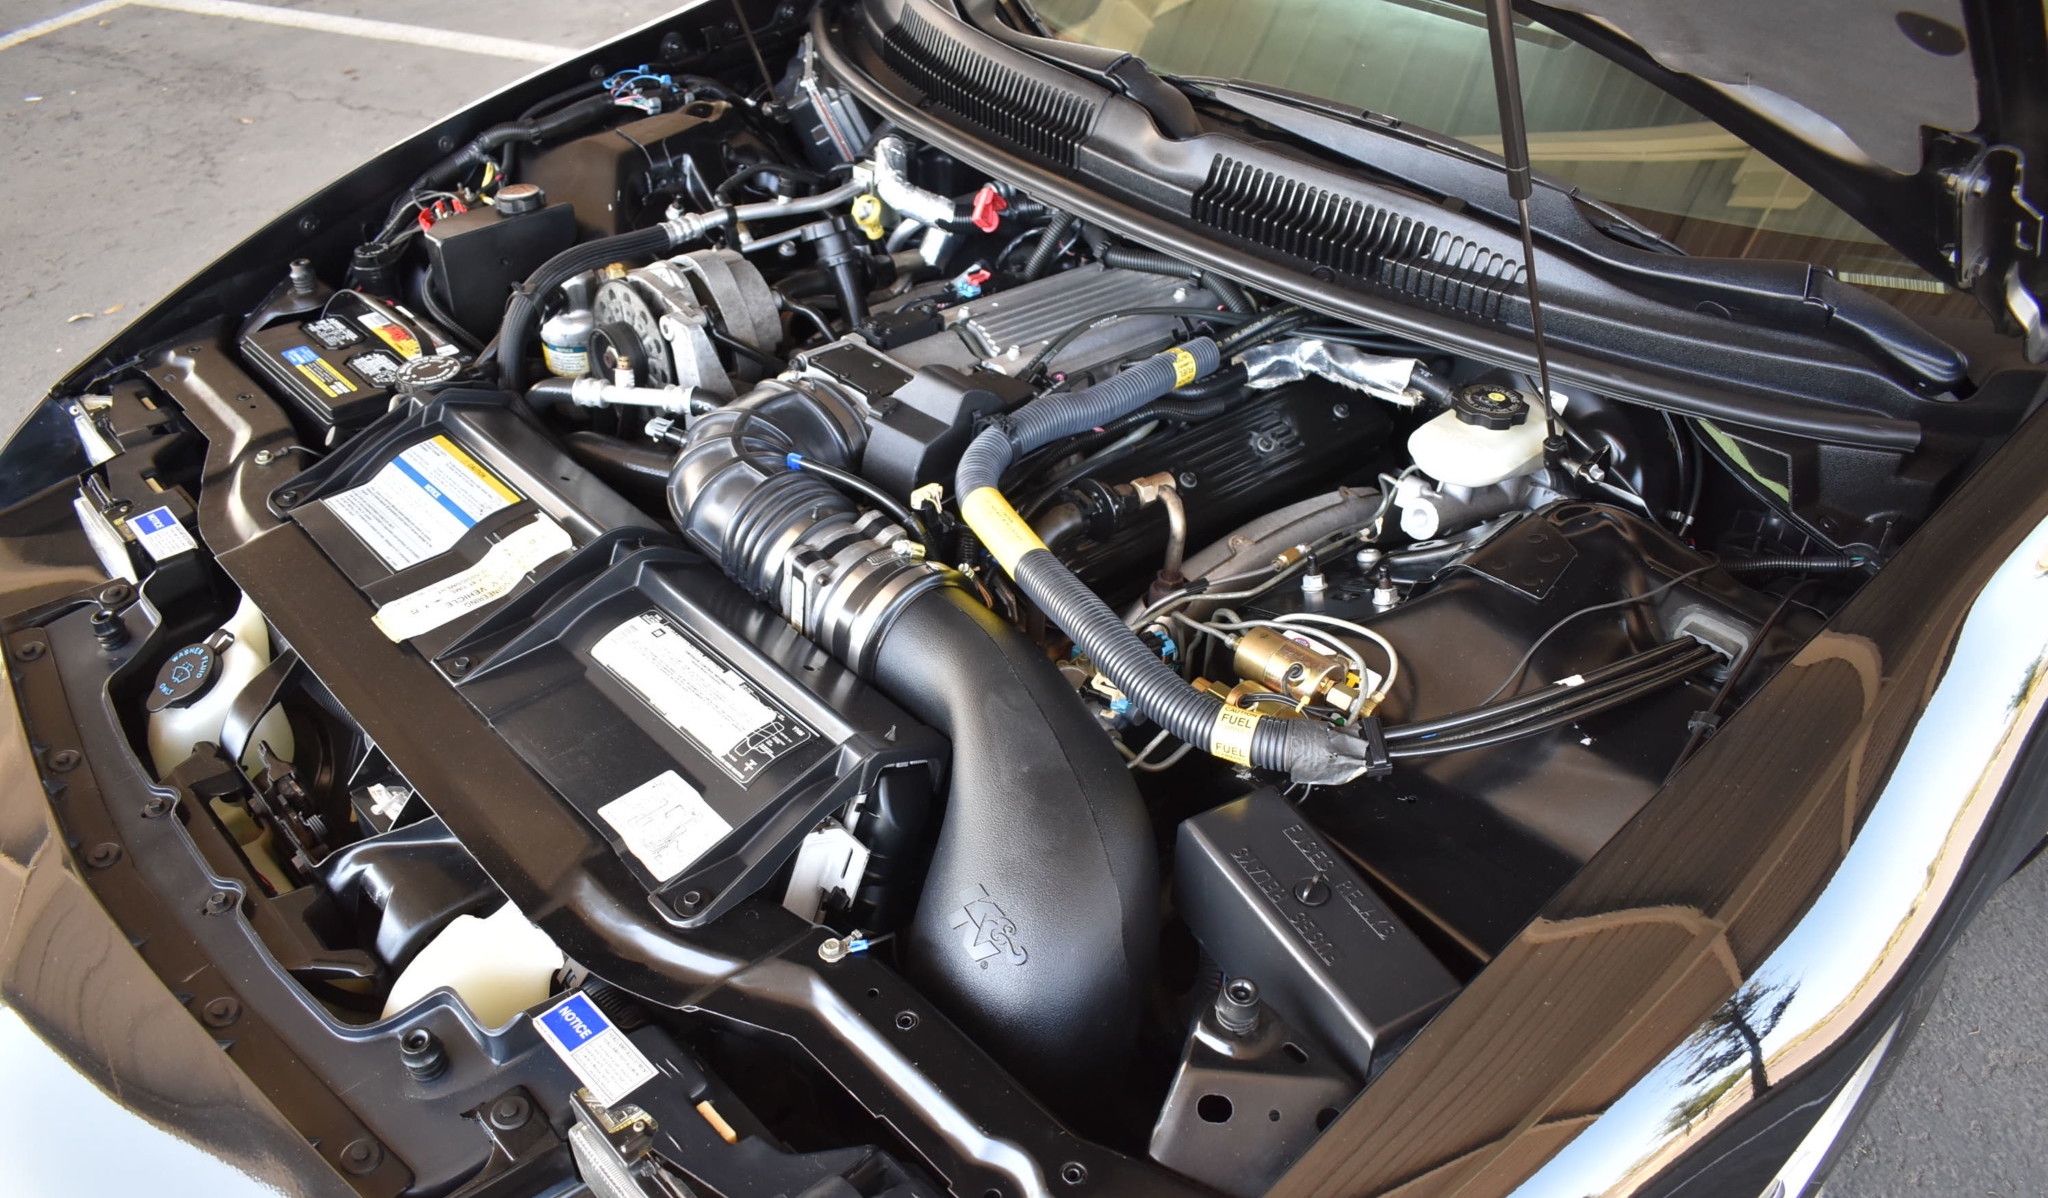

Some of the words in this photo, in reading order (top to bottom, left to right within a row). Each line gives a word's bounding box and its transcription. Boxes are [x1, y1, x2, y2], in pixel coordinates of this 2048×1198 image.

[447, 587, 488, 608] VEHICLE
[172, 646, 205, 663] WASHER
[196, 655, 209, 679] FLUID
[159, 682, 175, 696] ONLY
[1225, 706, 1258, 718] CAUTION
[1221, 713, 1252, 729] FUEL
[1215, 742, 1246, 758] FUEL
[558, 1005, 593, 1040] NOTICE
